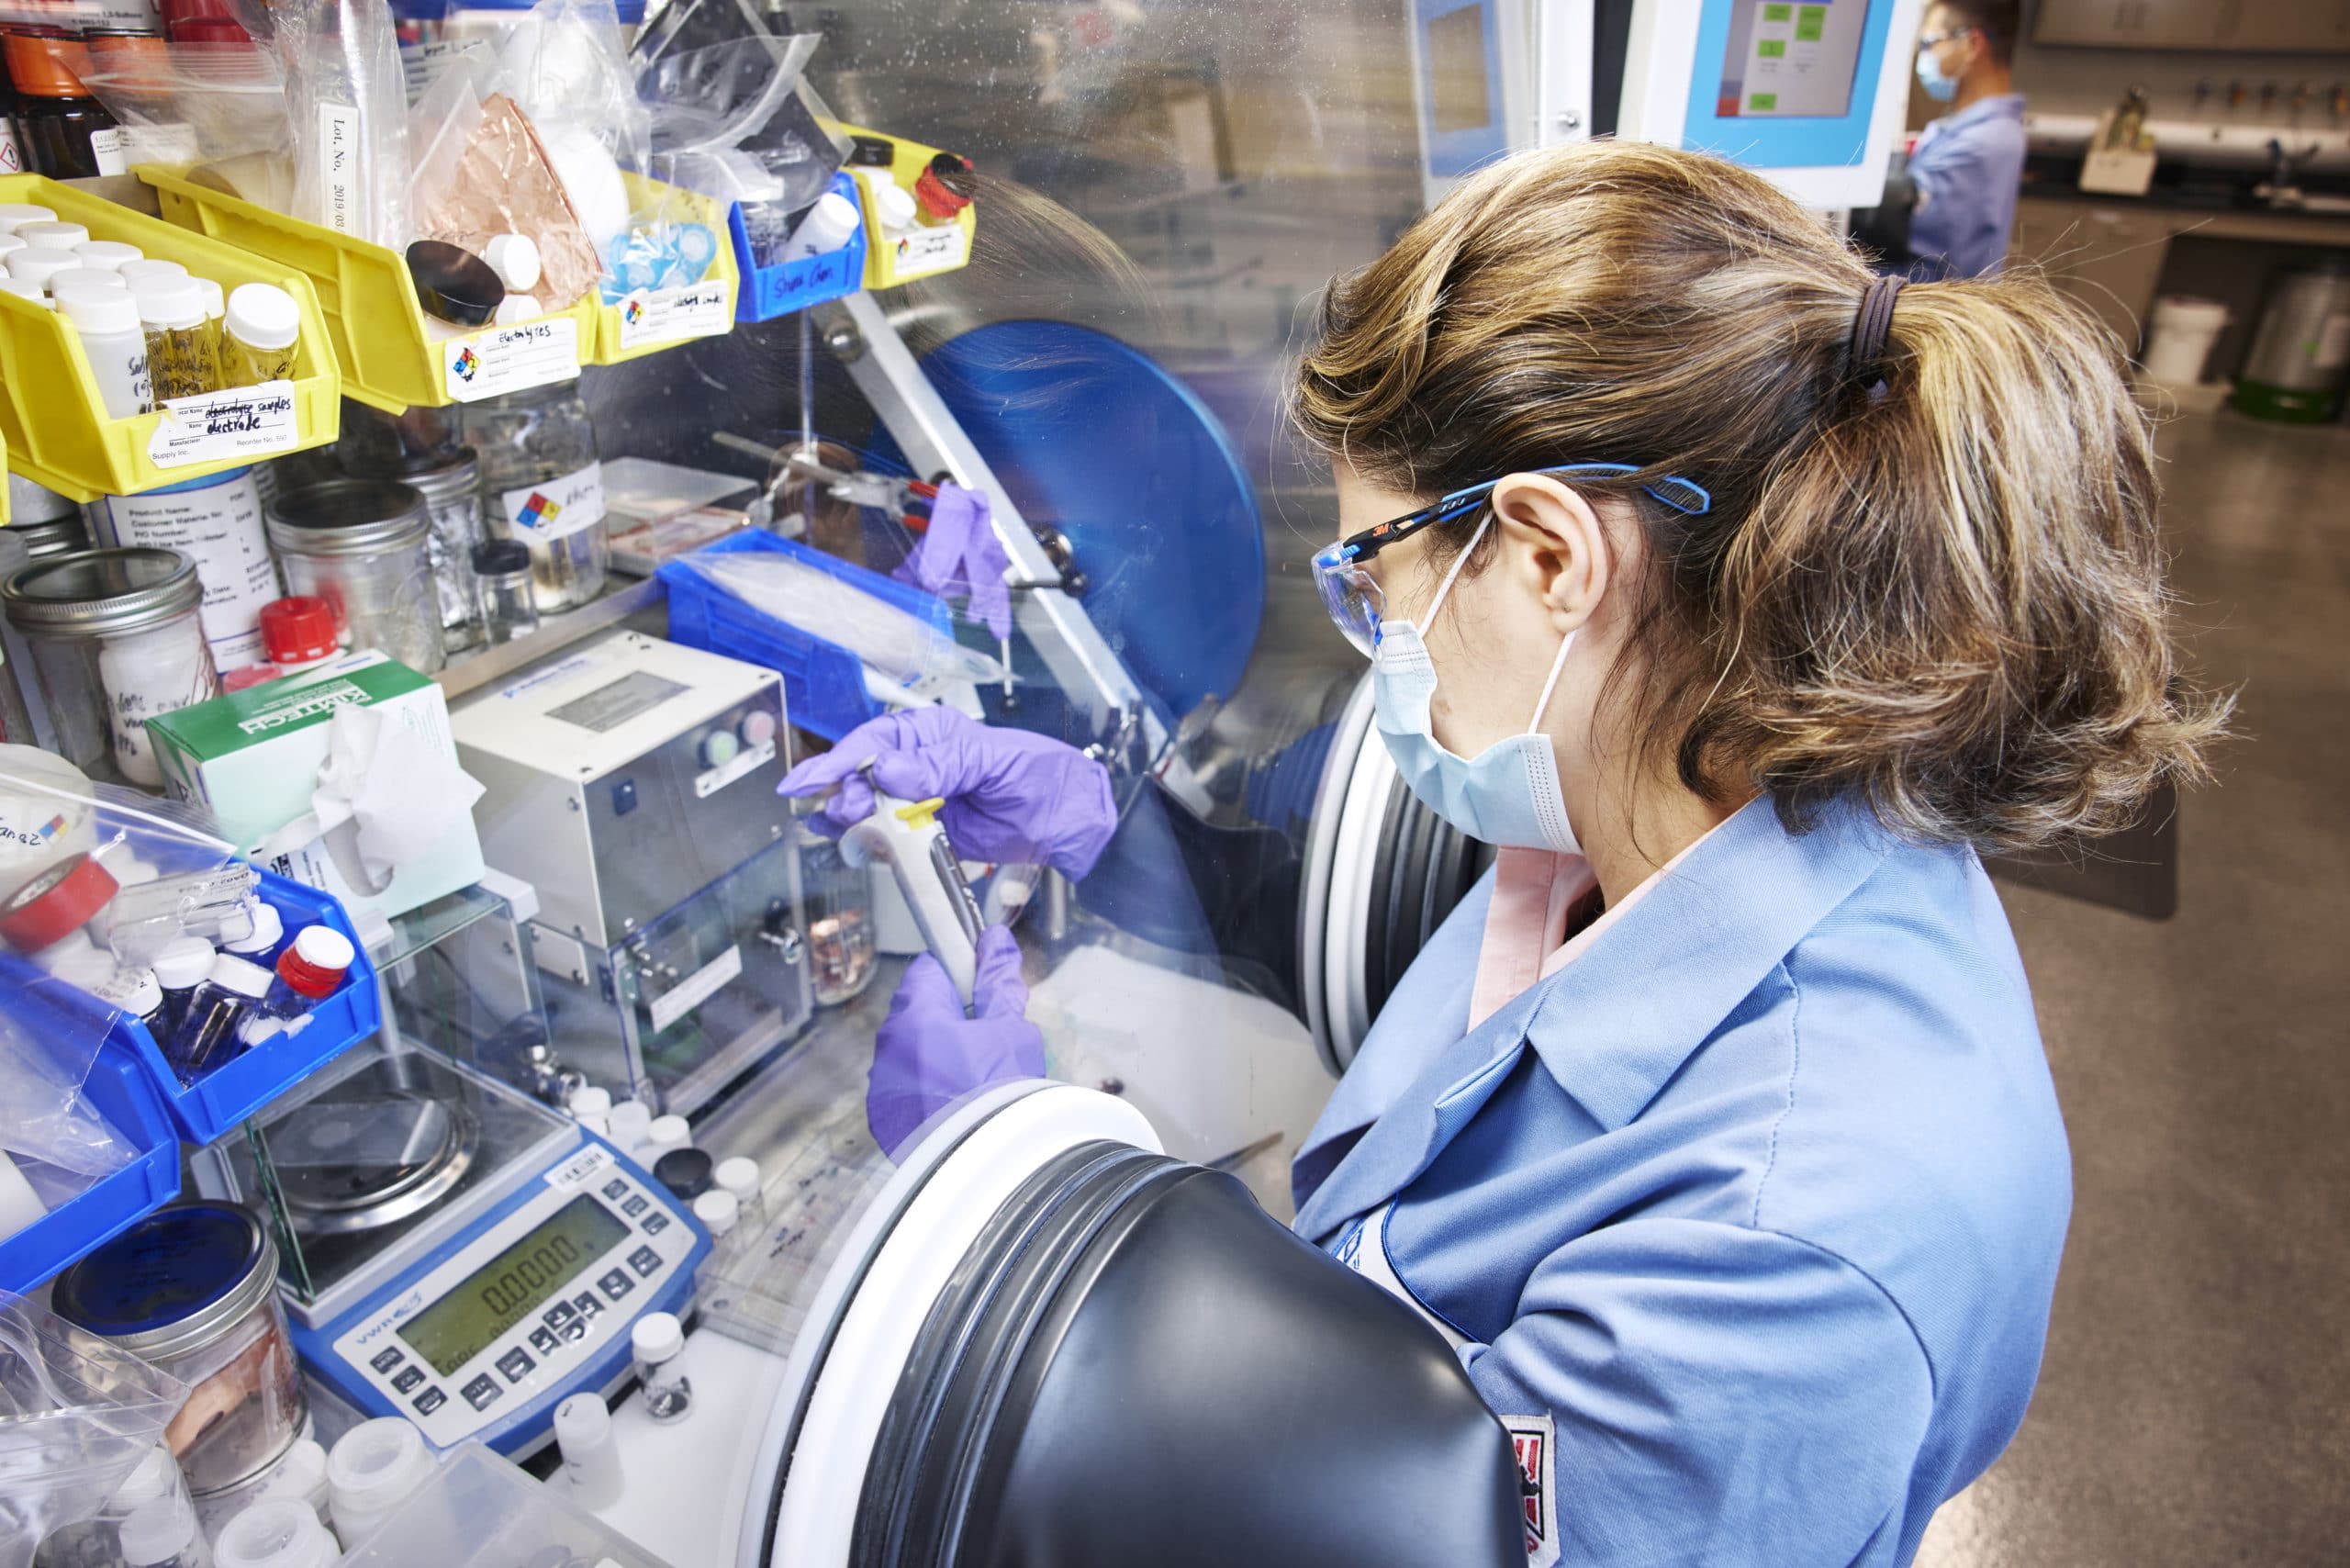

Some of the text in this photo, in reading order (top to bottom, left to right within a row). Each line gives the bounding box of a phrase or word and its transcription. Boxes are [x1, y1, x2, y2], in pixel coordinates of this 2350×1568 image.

[333, 119, 345, 145] Lot.
[333, 150, 345, 172] No.
[236, 439, 263, 447] Reorder
[263, 436, 274, 444] No.
[151, 450, 176, 460] Supply
[1372, 522, 1390, 537] 3M
[237, 686, 373, 734] KIMTECH
